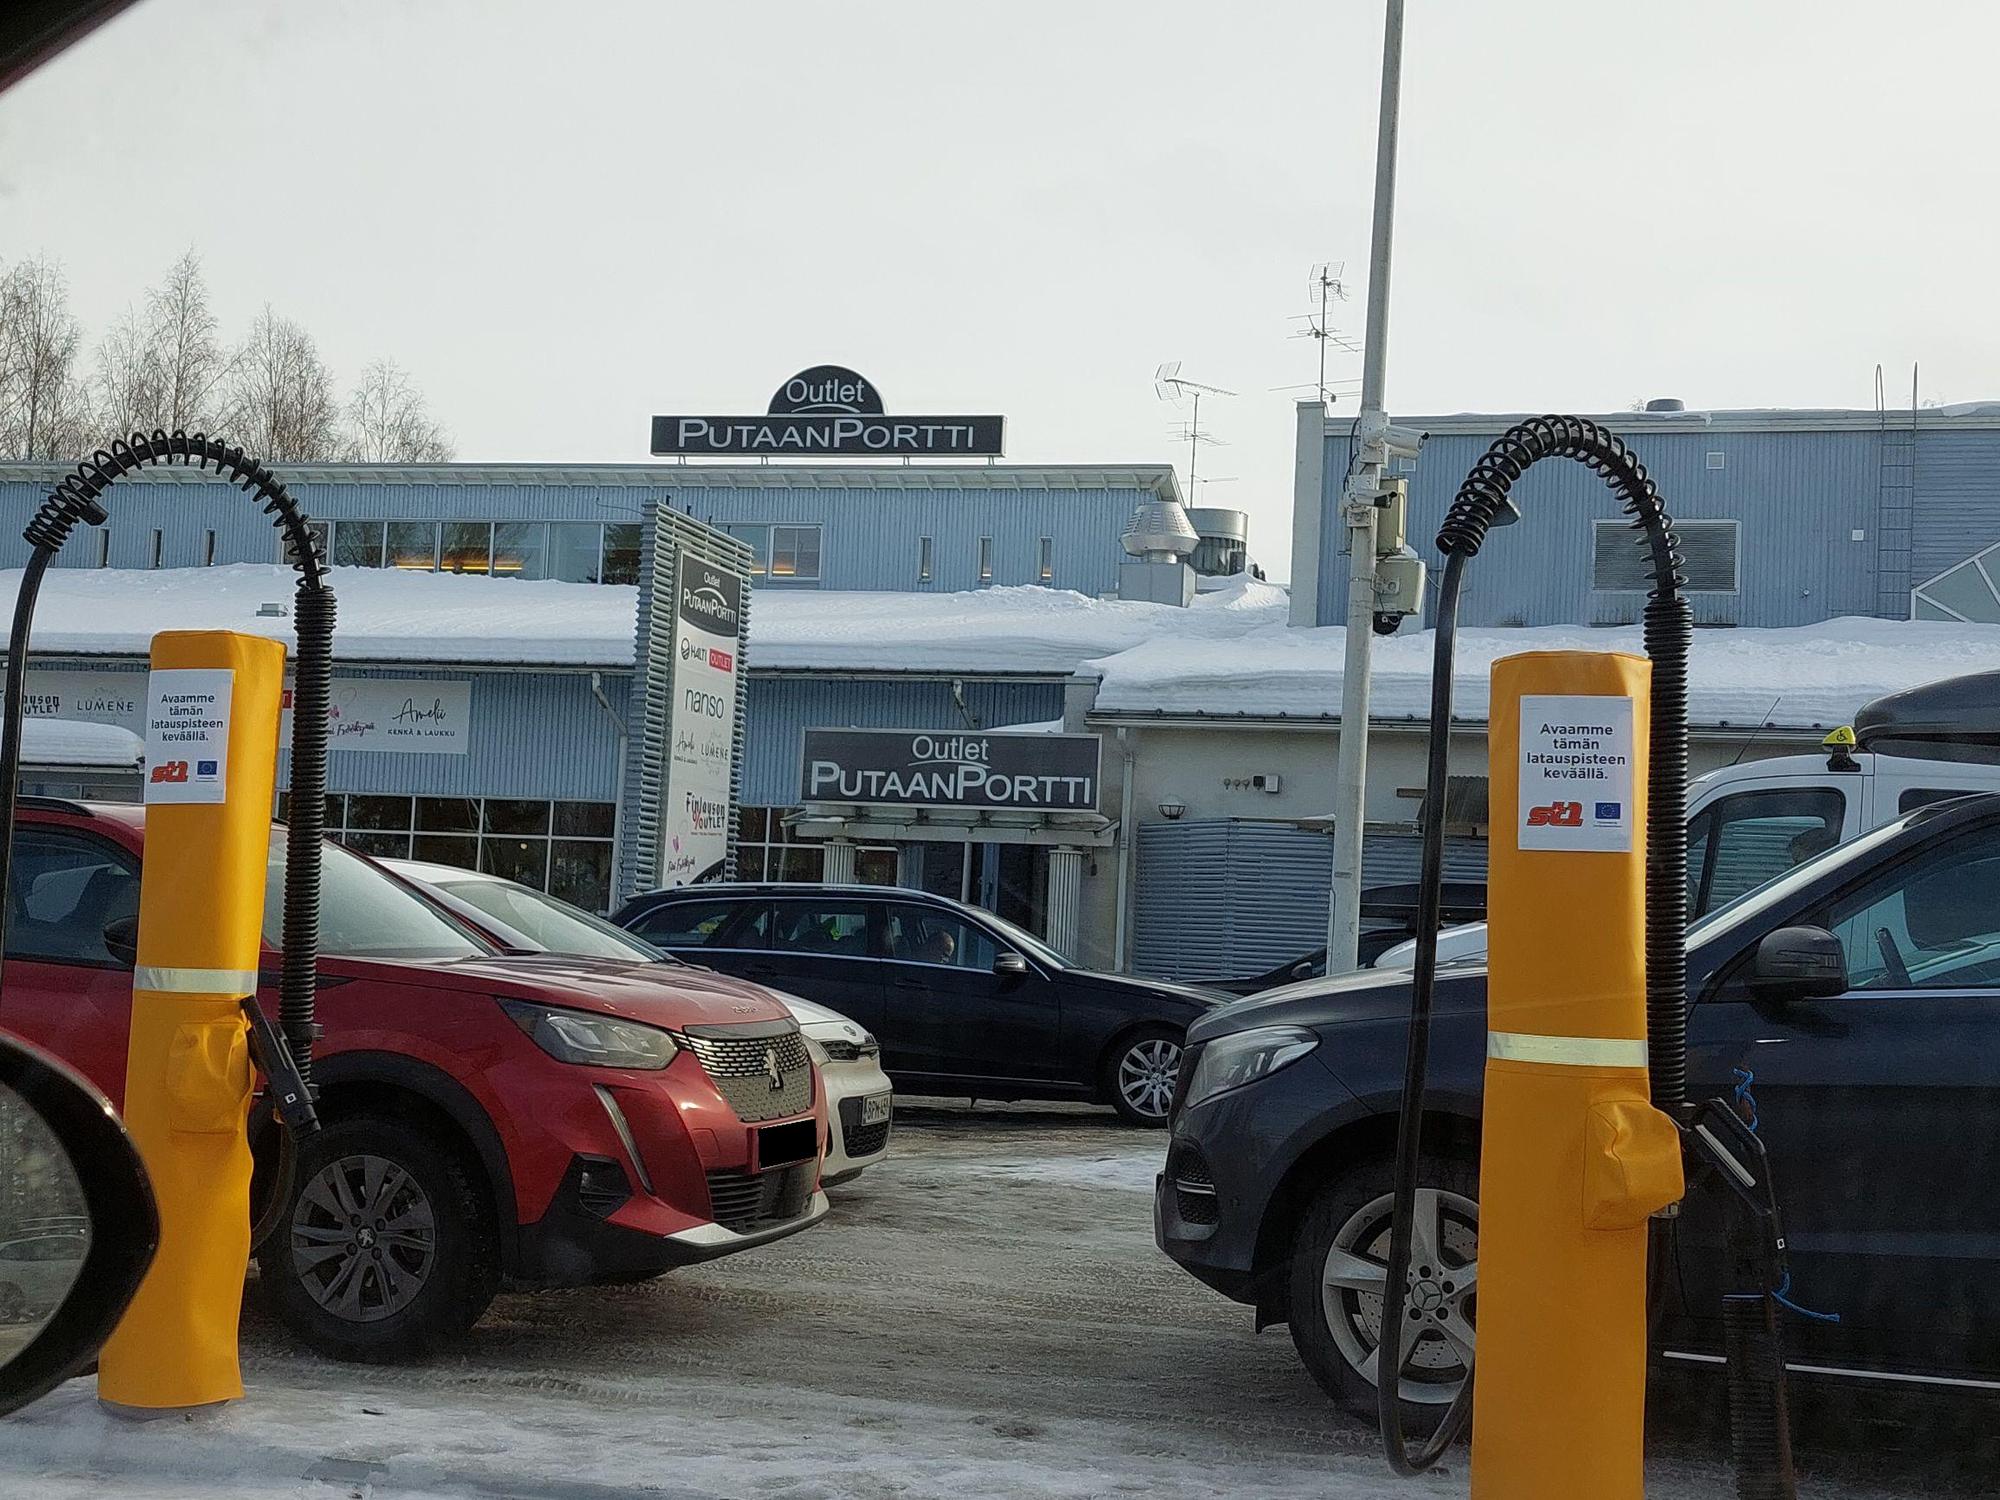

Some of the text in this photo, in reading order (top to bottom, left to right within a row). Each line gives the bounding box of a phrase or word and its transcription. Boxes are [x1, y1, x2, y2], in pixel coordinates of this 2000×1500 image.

[786, 378, 865, 403] Outlet
[678, 419, 973, 448] PUTAANPORTTI
[703, 571, 721, 588] Outlet
[683, 587, 737, 624] PUTAANPORTTI
[711, 652, 732, 670] OUTLET
[77, 698, 135, 712] LUMENE
[161, 693, 215, 704] Avaamme
[685, 688, 725, 719] nanso
[24, 704, 60, 714] UTLET
[169, 705, 204, 716] tämän
[151, 719, 224, 730] latauspisteen
[1540, 723, 1614, 735] Avaamme
[162, 731, 209, 742] keväällä.
[424, 729, 456, 738] LAUKKU
[912, 735, 990, 761] Outlet
[1553, 738, 1600, 750] tämän
[1526, 752, 1626, 767] latauspisteen
[1543, 767, 1609, 780] keväällä.
[810, 761, 1091, 805] PUTAANPORTTI
